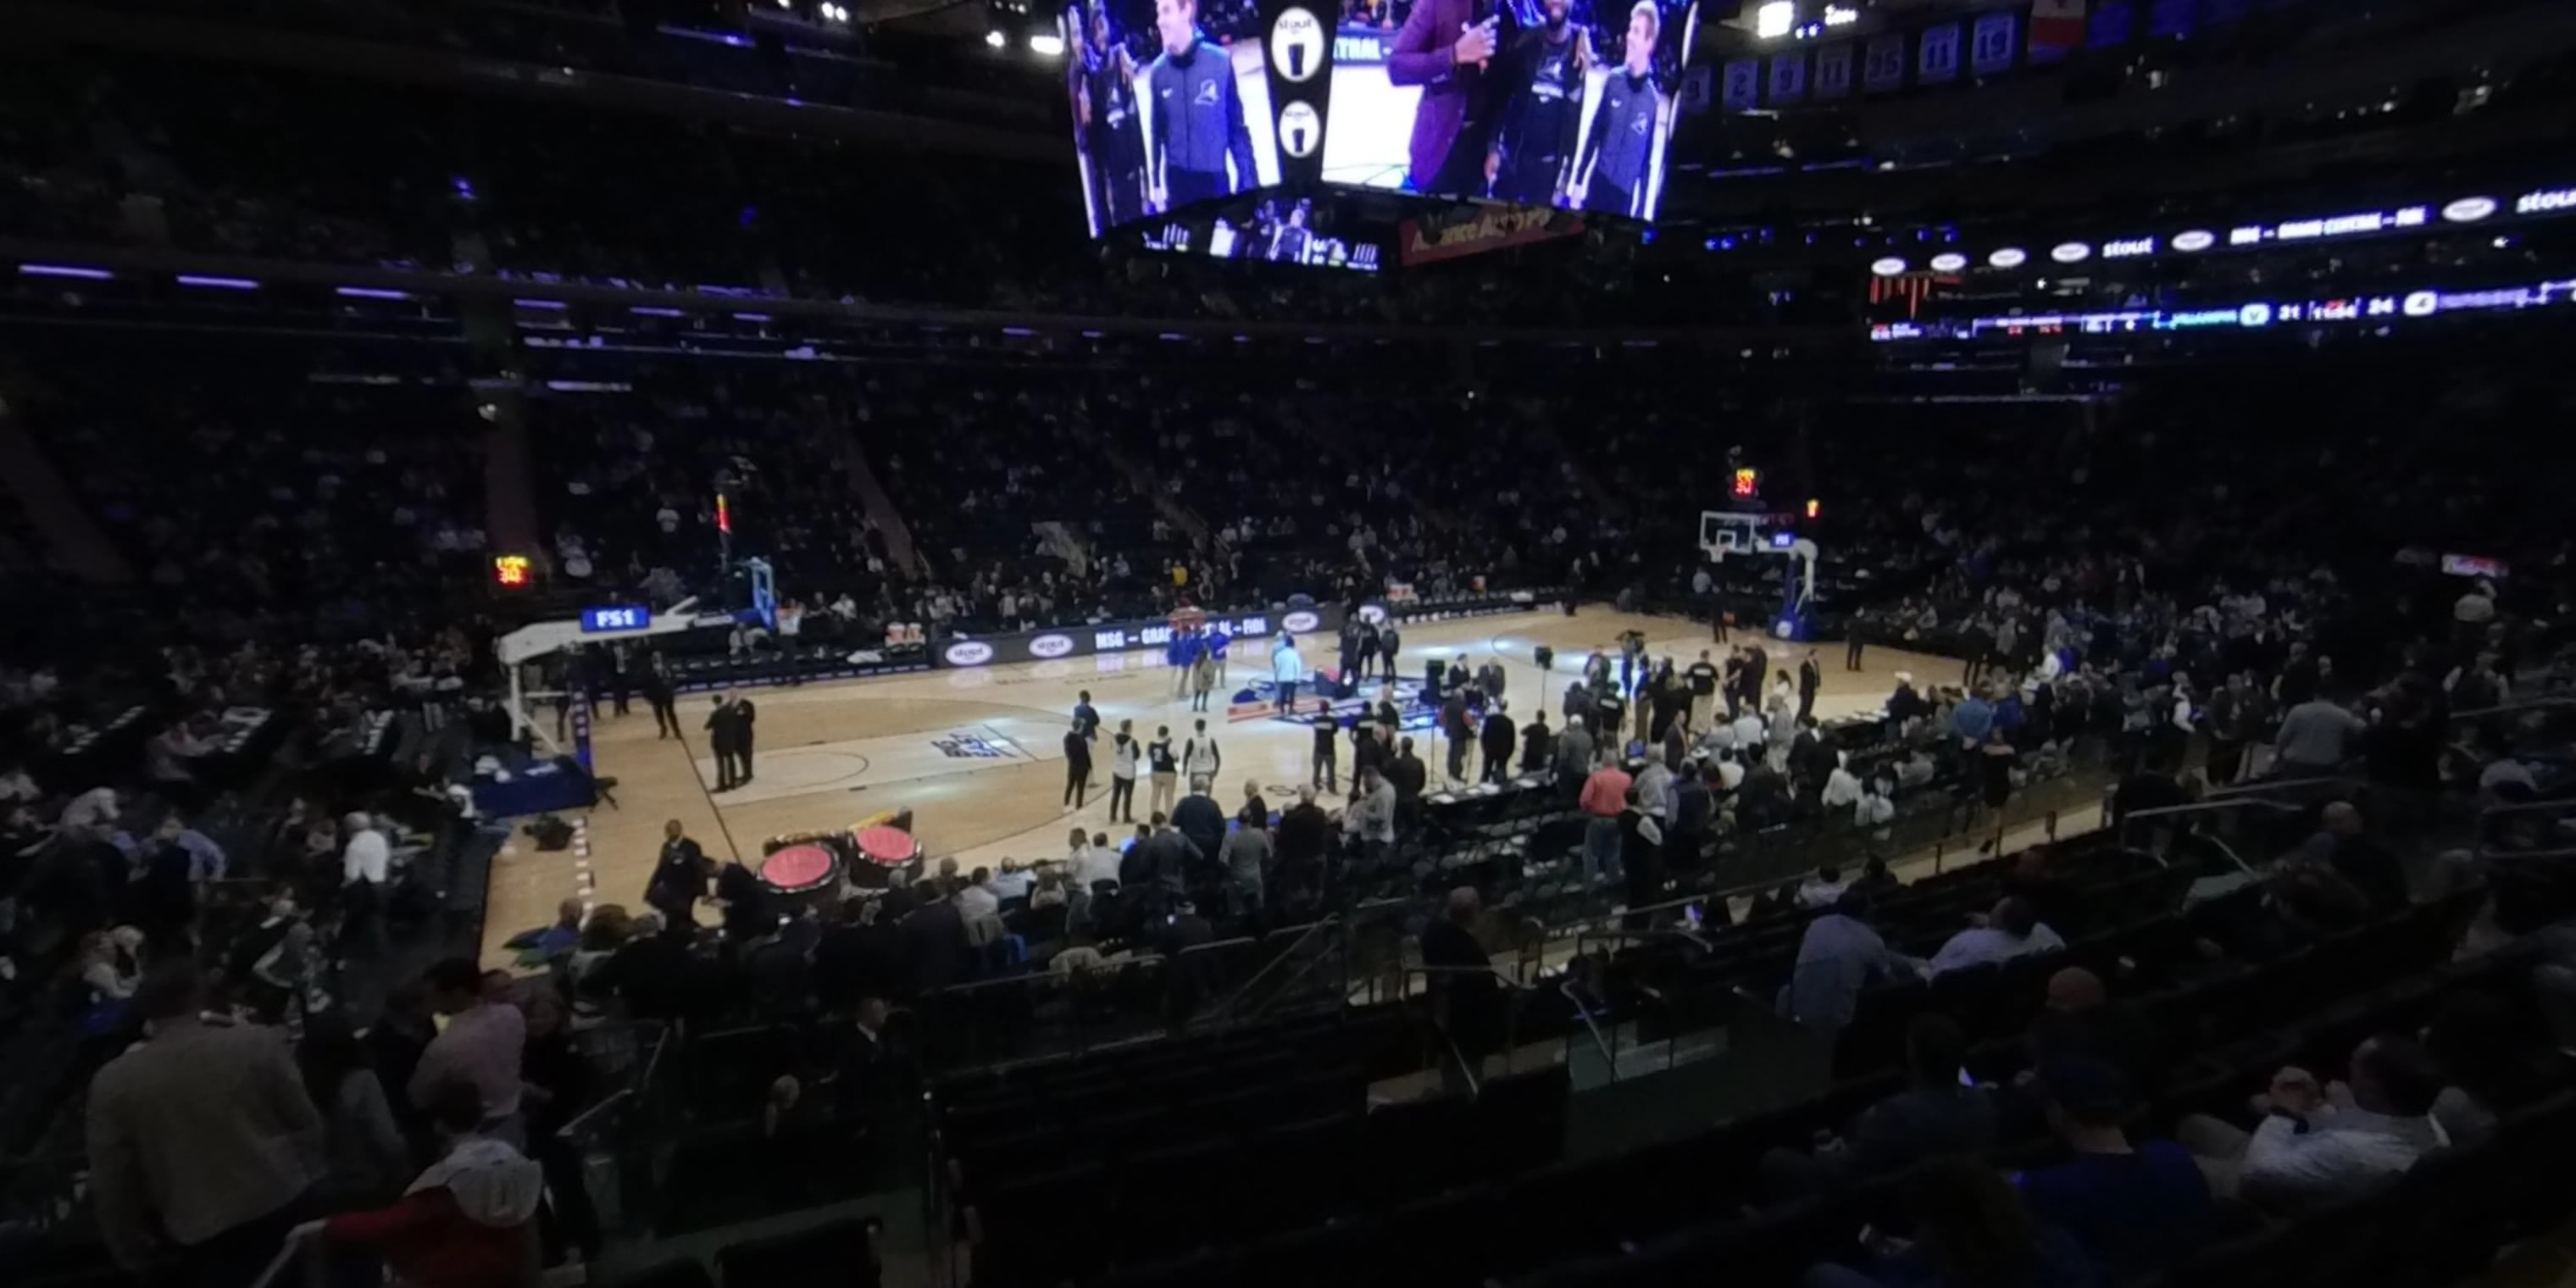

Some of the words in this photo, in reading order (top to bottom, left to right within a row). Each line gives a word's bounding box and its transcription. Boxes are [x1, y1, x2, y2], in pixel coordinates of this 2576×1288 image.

[2102, 237, 2153, 258] stout
[597, 609, 635, 628] FS1
[1096, 631, 1125, 650] MSG
